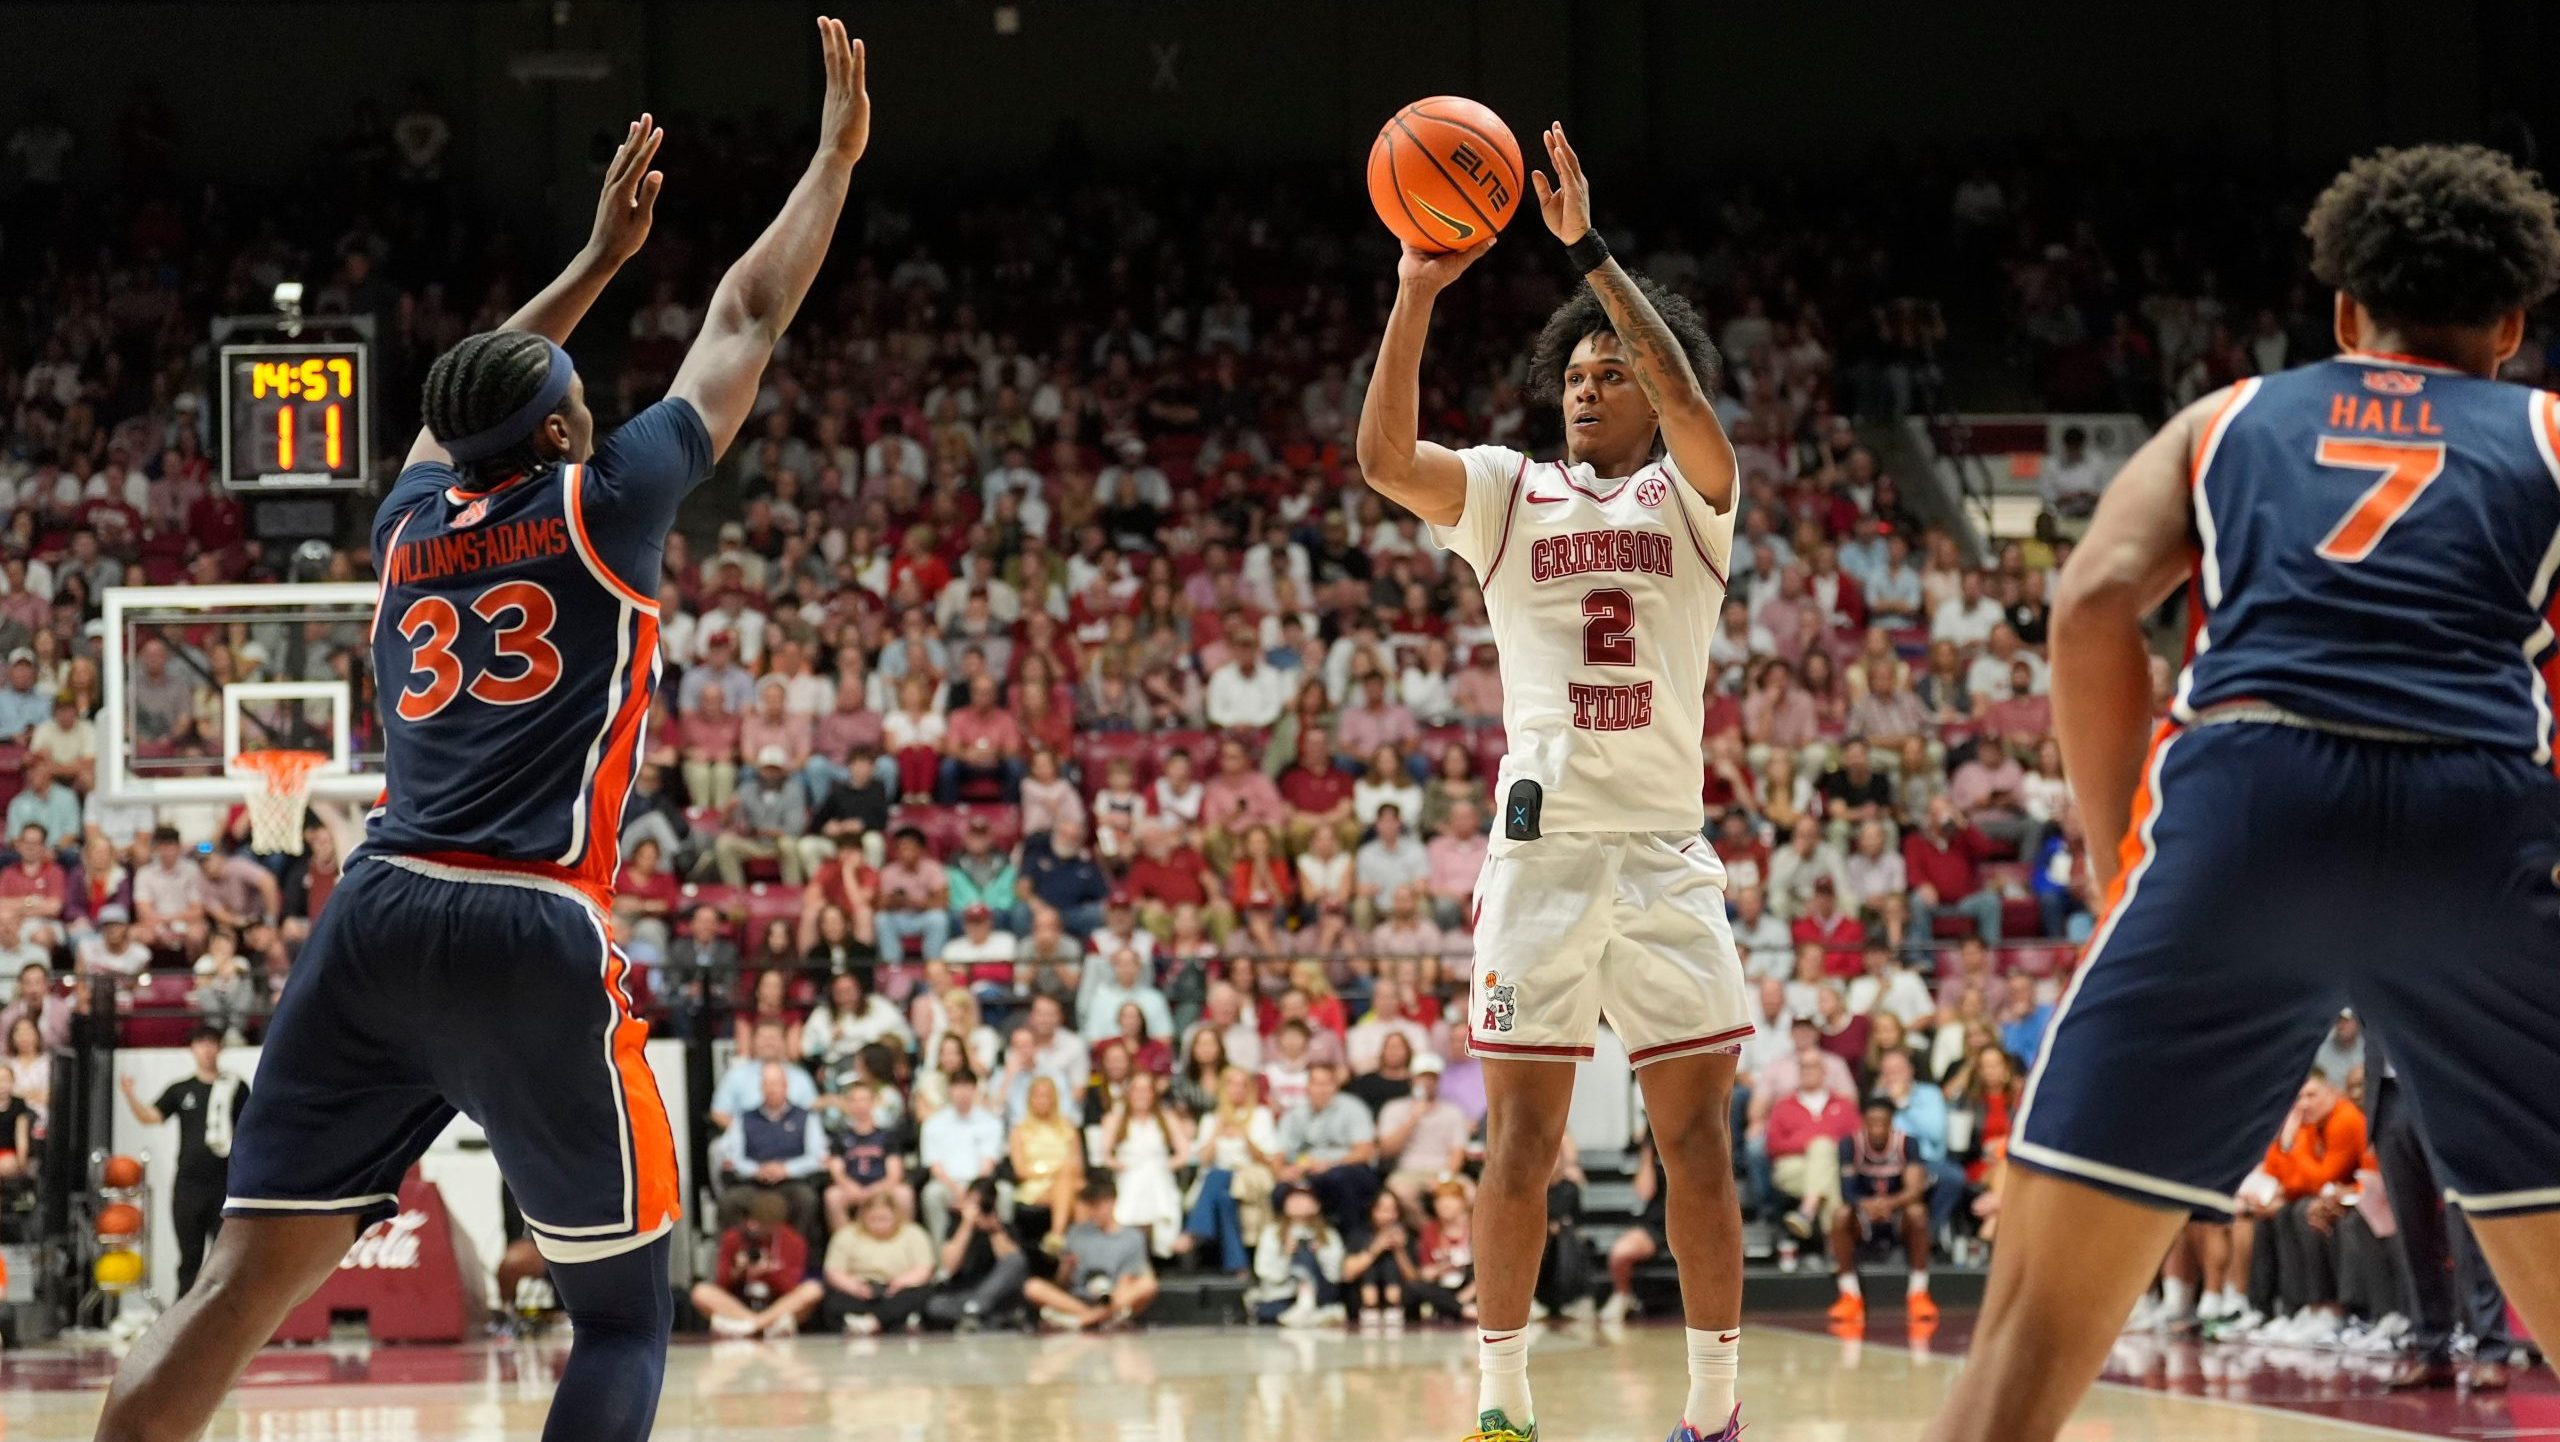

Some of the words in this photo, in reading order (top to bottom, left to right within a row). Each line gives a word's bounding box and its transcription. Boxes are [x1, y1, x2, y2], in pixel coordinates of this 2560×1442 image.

[1449, 142, 1511, 213] ELITE
[253, 358, 352, 401] 14:57
[278, 403, 342, 470] 11
[2330, 393, 2444, 436] HALL
[1637, 479, 1666, 506] SEC
[2314, 435, 2447, 564] 7
[390, 517, 568, 587] WILLIAMS-ADAMS
[1531, 530, 1673, 583] CRIMSON
[396, 580, 563, 722] 33
[1581, 587, 1636, 667] 2
[1568, 680, 1652, 731] TIDE
